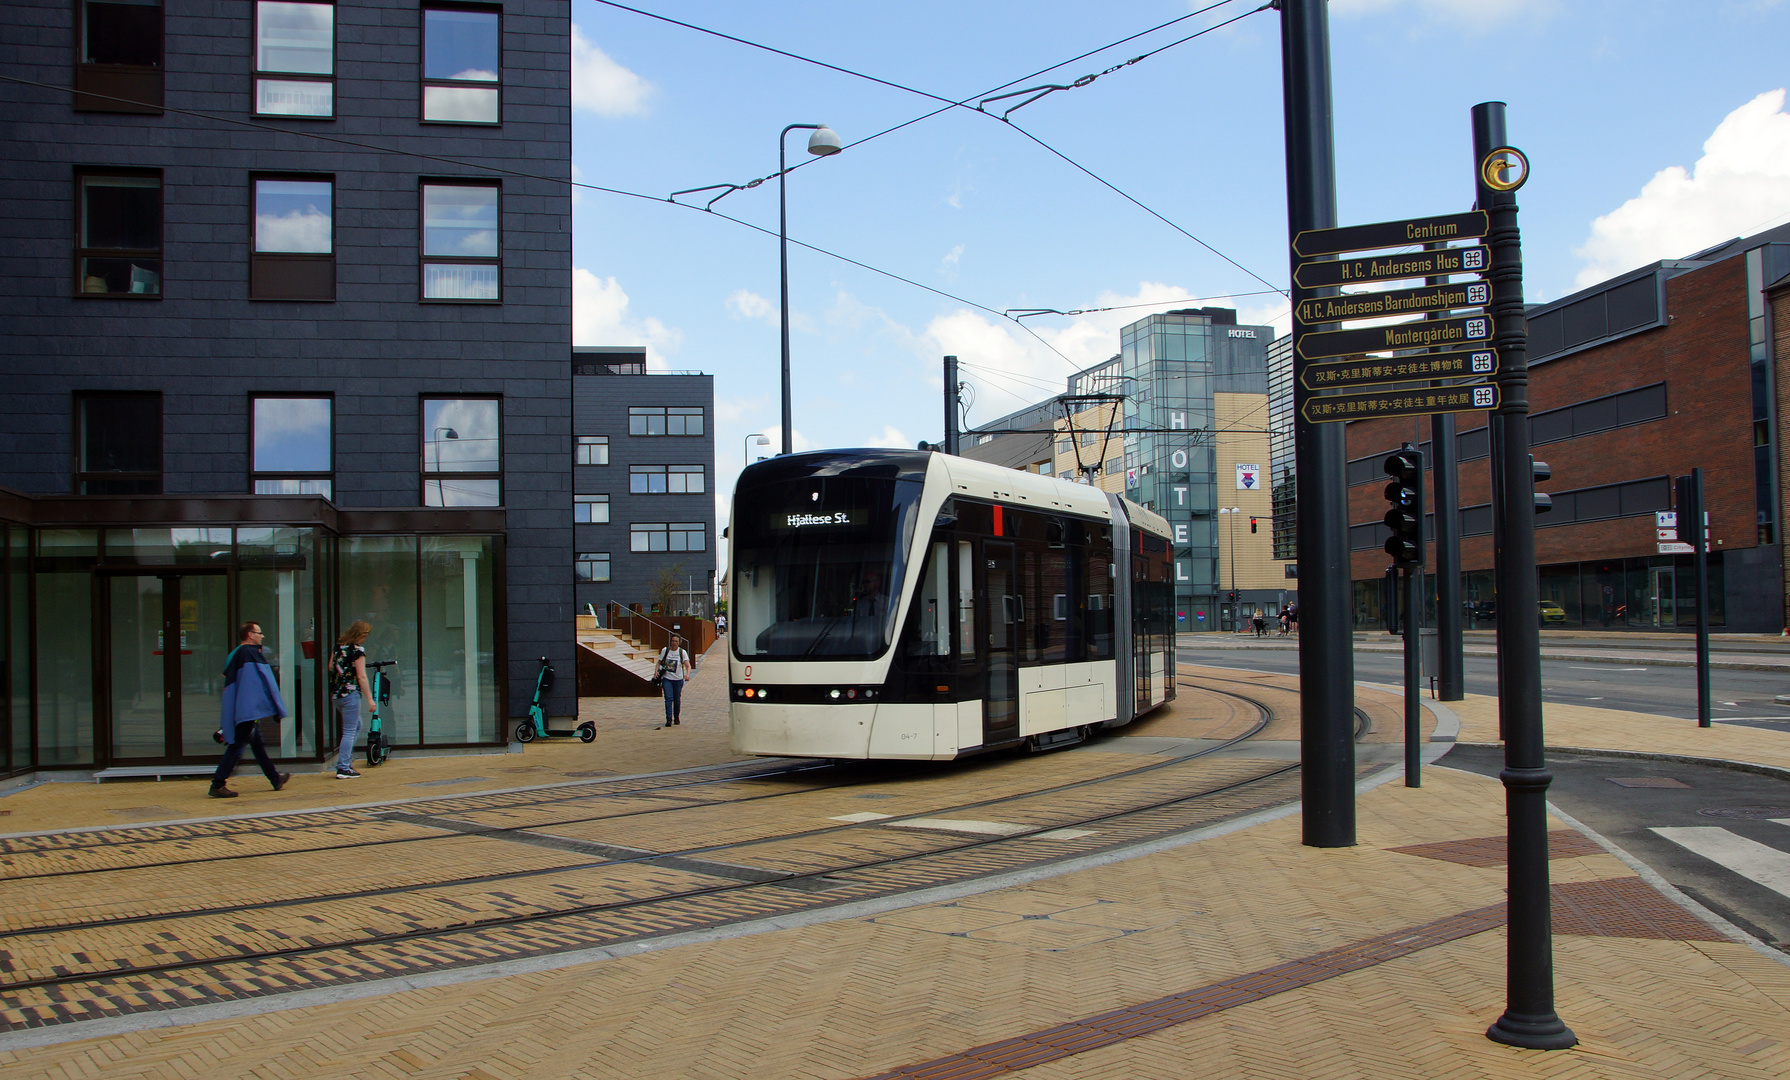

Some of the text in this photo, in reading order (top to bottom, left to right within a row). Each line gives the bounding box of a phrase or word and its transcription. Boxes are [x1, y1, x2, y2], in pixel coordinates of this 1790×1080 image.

[1407, 223, 1457, 239] Centrum
[1370, 259, 1432, 276] Andersens
[1437, 254, 1459, 270] Hus
[1327, 299, 1383, 317] Andersens
[1385, 291, 1465, 311] Barndomshjem
[1228, 329, 1257, 339] HOTEL
[1386, 324, 1462, 345] Møntergården
[1171, 412, 1189, 581] HOTEL
[787, 512, 850, 528] Hjallese St.
